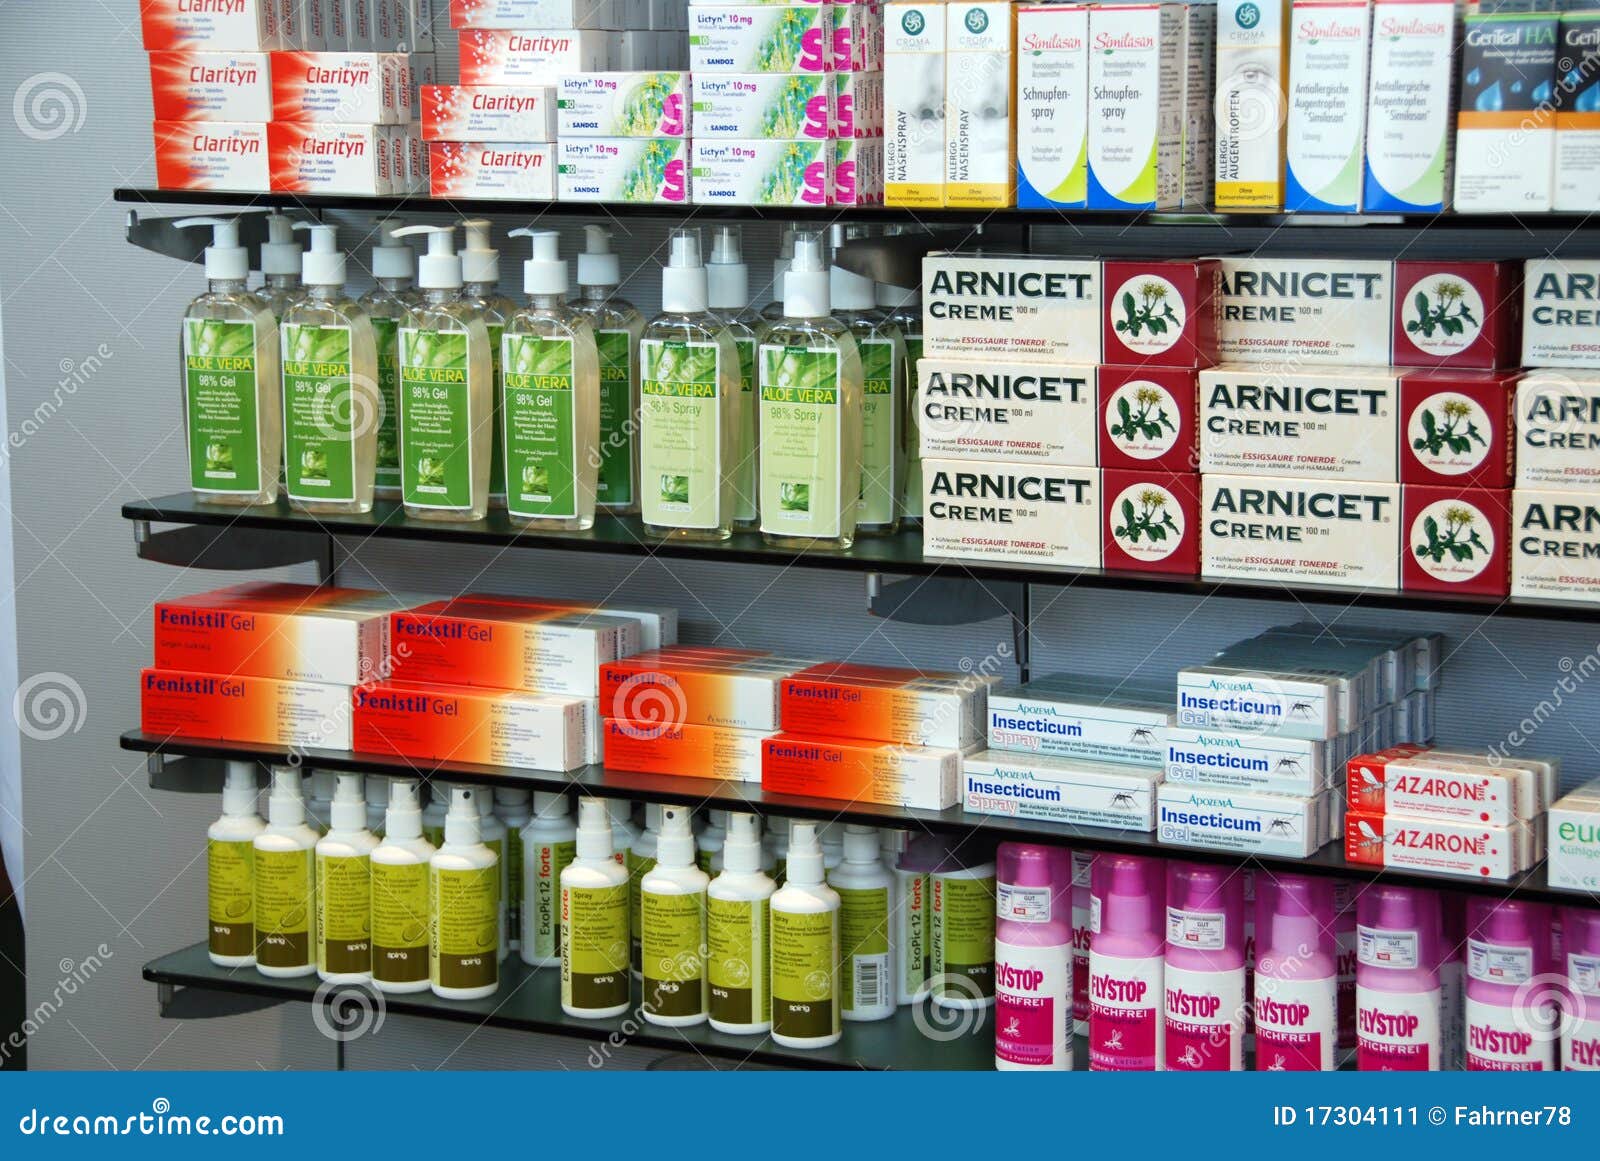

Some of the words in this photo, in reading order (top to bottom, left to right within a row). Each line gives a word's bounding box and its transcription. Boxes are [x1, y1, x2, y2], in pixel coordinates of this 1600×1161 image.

[177, 0, 246, 15] Clarityn
[729, 15, 738, 23] 10
[740, 17, 752, 25] mg
[1379, 17, 1445, 38] Similasan
[1298, 20, 1361, 40] Similasan
[1467, 28, 1520, 46] GenTeal
[1525, 28, 1556, 44] HA
[508, 36, 570, 55] Clarityn
[896, 38, 930, 46] CROMA
[1022, 33, 1082, 51] Similasan
[1093, 31, 1154, 50] Similasan
[190, 66, 258, 86] Clarityn
[306, 66, 369, 87] Clarityn
[594, 79, 604, 88] 10
[605, 82, 617, 90] mg
[733, 81, 742, 90] 10
[744, 84, 757, 92] mg
[1023, 87, 1071, 103] Schnupfen-
[1094, 85, 1143, 102] Schnupfen-
[1295, 83, 1349, 95] Antiallergische
[1374, 80, 1430, 93] Antiallergische
[472, 94, 536, 113] Clarityn
[1294, 98, 1346, 110] Augentropfen
[1373, 95, 1427, 108] Augentropfen
[1031, 106, 1055, 120] spray
[1102, 105, 1126, 120] spray
[1229, 90, 1240, 180] AUGENTROPFEN
[193, 135, 260, 155] Clarityn
[302, 137, 365, 158] Clarityn
[732, 148, 741, 156] 10
[743, 150, 756, 158] mg
[897, 110, 907, 181] NASENSPRAY
[960, 109, 970, 181] NASENSPRAY
[481, 151, 543, 170] Clarityn
[1219, 137, 1228, 180] ALLERGO-
[930, 270, 1091, 298] ARNICET
[929, 301, 1014, 320] CREME
[1016, 306, 1030, 314] 100
[1031, 306, 1038, 314] ml
[188, 356, 213, 370] ALOE
[217, 357, 253, 371] VERA
[284, 361, 308, 375] ALOE
[313, 363, 347, 376] VERA
[199, 375, 218, 386] 98%
[219, 375, 236, 387] Gel
[403, 368, 427, 381] ALOE
[430, 369, 465, 382] VERA
[506, 374, 530, 387] ALOE
[533, 376, 569, 389] VERA
[295, 381, 313, 392] 98%
[315, 382, 331, 393] Gel
[412, 387, 430, 398] 98%
[432, 387, 448, 399] Gel
[643, 380, 671, 394] ALOE
[677, 382, 714, 396] VERA
[763, 388, 793, 402] ALOE
[797, 390, 834, 403] VERA
[925, 371, 1086, 401] ARNICET
[516, 394, 534, 405] 98%
[536, 394, 553, 406] Gel
[1208, 384, 1387, 415] ARNICET
[673, 402, 702, 417] Spray
[771, 407, 790, 419] 98%
[793, 408, 823, 422] Spray
[925, 403, 1009, 424] CREME
[1011, 408, 1025, 417] 100
[1026, 409, 1033, 417] ml
[1207, 415, 1300, 437] CREME
[1296, 455, 1336, 464] TONERDE
[930, 471, 1091, 503] ARNICET
[929, 501, 1013, 523] CREME
[1211, 487, 1390, 521] ARNICET
[1209, 519, 1303, 542] CREME
[1305, 527, 1318, 535] 100
[1298, 559, 1339, 569] TONERDE
[160, 609, 226, 629] Fenistil
[230, 615, 256, 631] Gel
[396, 619, 463, 639] Fenistil
[467, 626, 493, 641] Gel
[147, 675, 215, 694] Fenistil
[219, 682, 245, 697] Gel
[787, 684, 839, 700] Fenistil
[842, 690, 862, 702] Gel
[1181, 692, 1282, 716] Insecticum
[992, 713, 1082, 737] Insecticum
[1180, 711, 1210, 726] Gel
[992, 729, 1040, 750] Spray
[769, 745, 820, 761] Fenistil
[823, 750, 843, 763] Gel
[1169, 747, 1269, 771] Insecticum
[1168, 765, 1197, 780] Gel
[968, 777, 1061, 801] Insecticum
[1351, 768, 1359, 803] STIFT
[1393, 775, 1477, 800] AZARON
[968, 793, 1018, 815] Spray
[1161, 807, 1262, 832] Insecticum
[1161, 825, 1190, 841] Gel
[1349, 822, 1358, 857] STIFT
[1392, 829, 1478, 854] AZARON
[539, 847, 551, 878] forte
[540, 881, 550, 893] 12
[911, 878, 922, 911] forte
[540, 895, 550, 936] ExoPic
[911, 914, 921, 926] 12
[911, 931, 921, 971] ExoPic
[1091, 974, 1147, 1003] FLYSTOP
[1091, 1003, 1147, 1018] STICHFREI
[1165, 988, 1221, 1018] FLYSTOP
[1165, 1019, 1221, 1034] STICHFREI
[1359, 1007, 1419, 1038] FLYSTOP
[1358, 1039, 1420, 1055] STICHFREI
[1469, 1024, 1532, 1055] FLYSTOP
